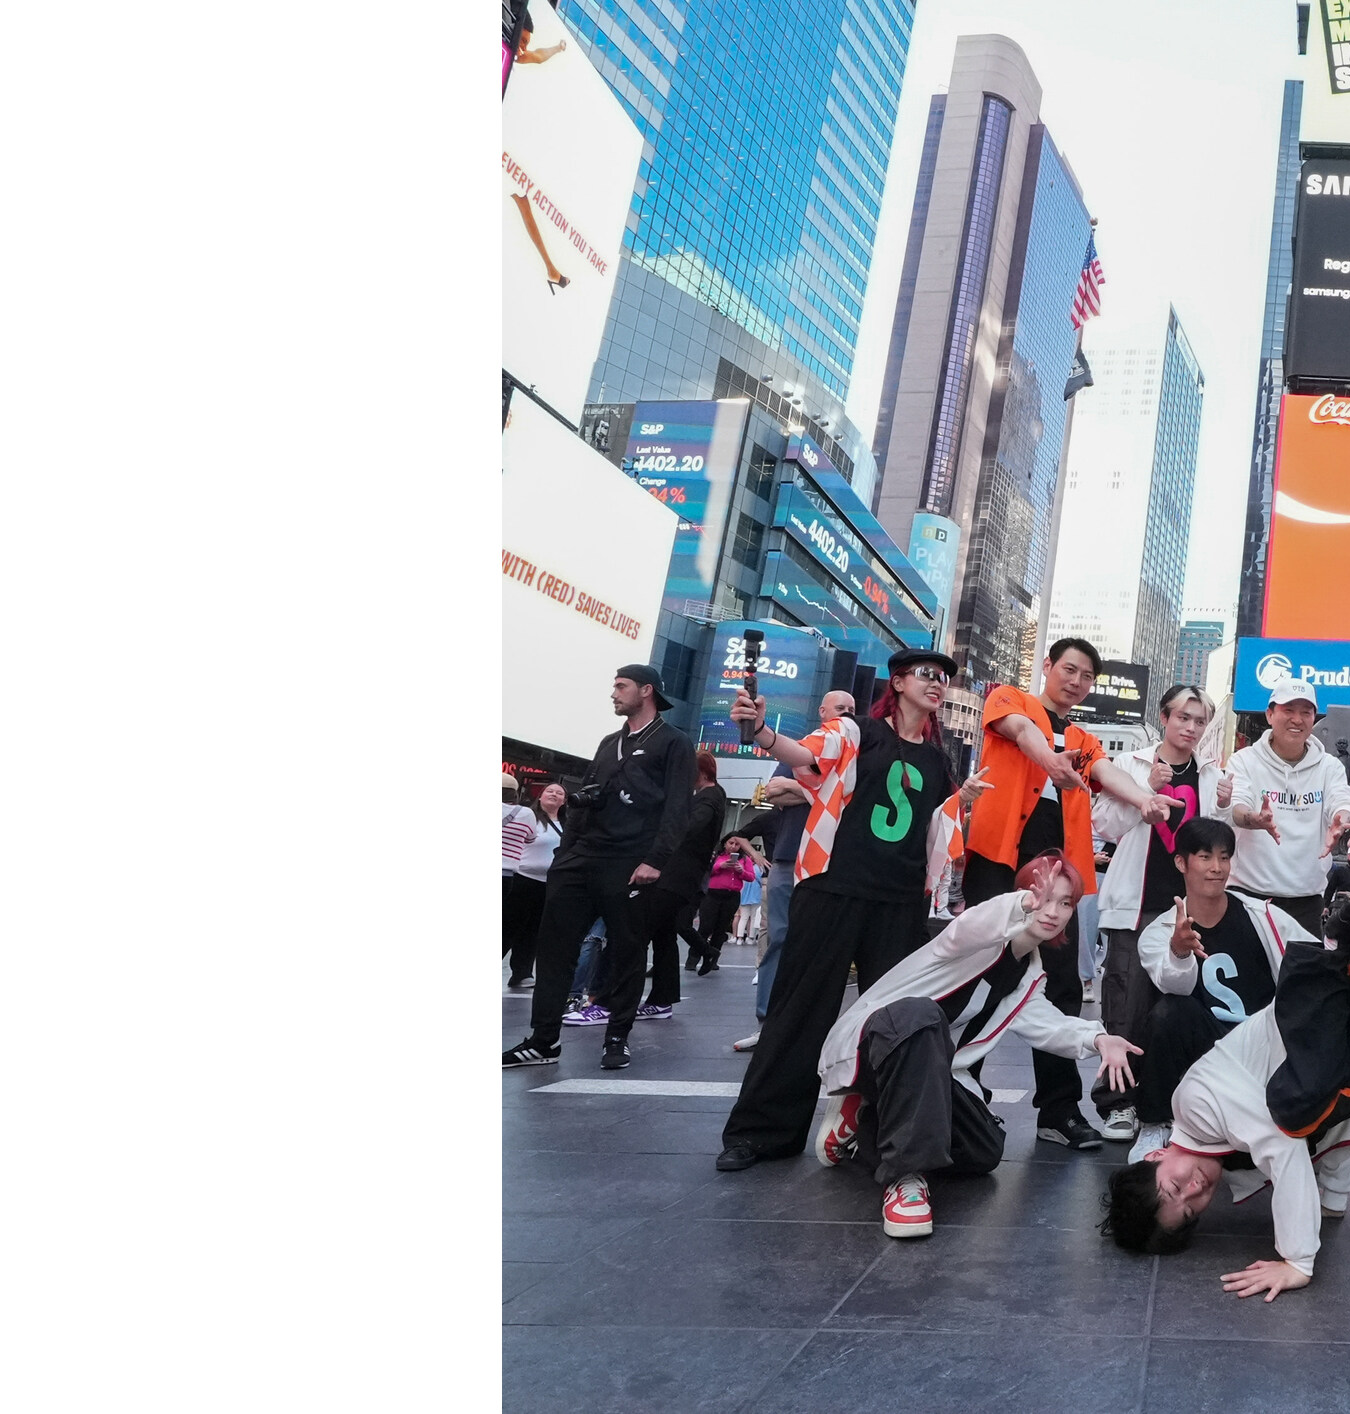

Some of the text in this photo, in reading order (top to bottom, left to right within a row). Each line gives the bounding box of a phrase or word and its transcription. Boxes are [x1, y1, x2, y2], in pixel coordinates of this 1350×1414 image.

[502, 151, 608, 277] EVERY ACTION YOU TAKE
[640, 424, 665, 435] S&P
[802, 443, 819, 467] S&P
[808, 519, 849, 573] 4402.20
[502, 549, 641, 640] WITH (RED) SAVES LIVES
[723, 653, 798, 679] 442.20
[869, 759, 924, 843] S
[1201, 952, 1251, 1023] S
